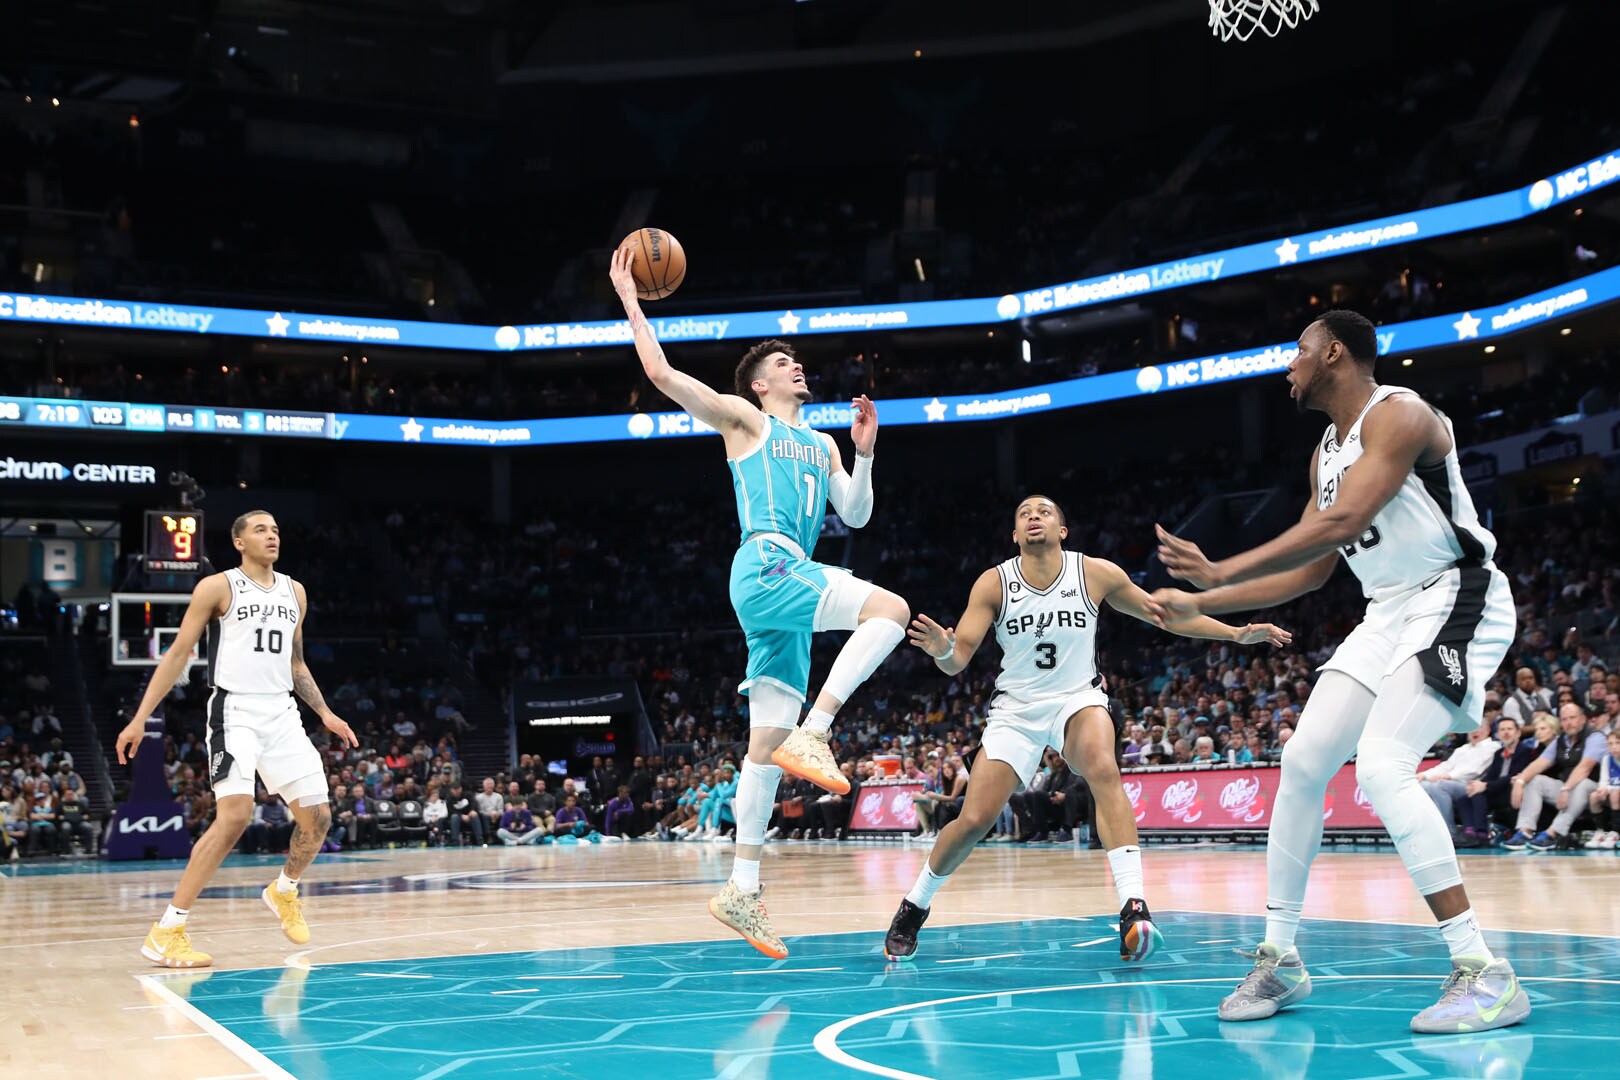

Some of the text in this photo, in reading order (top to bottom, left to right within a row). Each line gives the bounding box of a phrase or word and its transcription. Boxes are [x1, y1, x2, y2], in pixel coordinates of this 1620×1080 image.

[1556, 167, 1588, 198] NC
[1024, 258, 1224, 313] NC Education Lottery
[16, 296, 132, 324] Education
[133, 305, 213, 333] Lottery
[524, 319, 729, 347] NC Educati Lottery
[1167, 361, 1199, 387] NC
[36, 404, 80, 422] 7:19
[92, 406, 123, 424] 103
[129, 408, 165, 426] CHA
[200, 411, 209, 428] 1
[214, 414, 242, 429] TOL
[246, 415, 260, 430] 3
[659, 414, 690, 434] NC
[799, 403, 857, 425] Lotter
[73, 464, 156, 483] CENTER
[803, 472, 816, 518] 1
[174, 531, 192, 560] 9
[1061, 589, 1079, 599] Self.
[237, 604, 297, 624] SPURS
[1006, 610, 1087, 639] SPURS
[254, 628, 283, 654] 10
[1035, 643, 1057, 670] 3
[526, 692, 623, 707] GEICO
[119, 815, 183, 833] KIA
